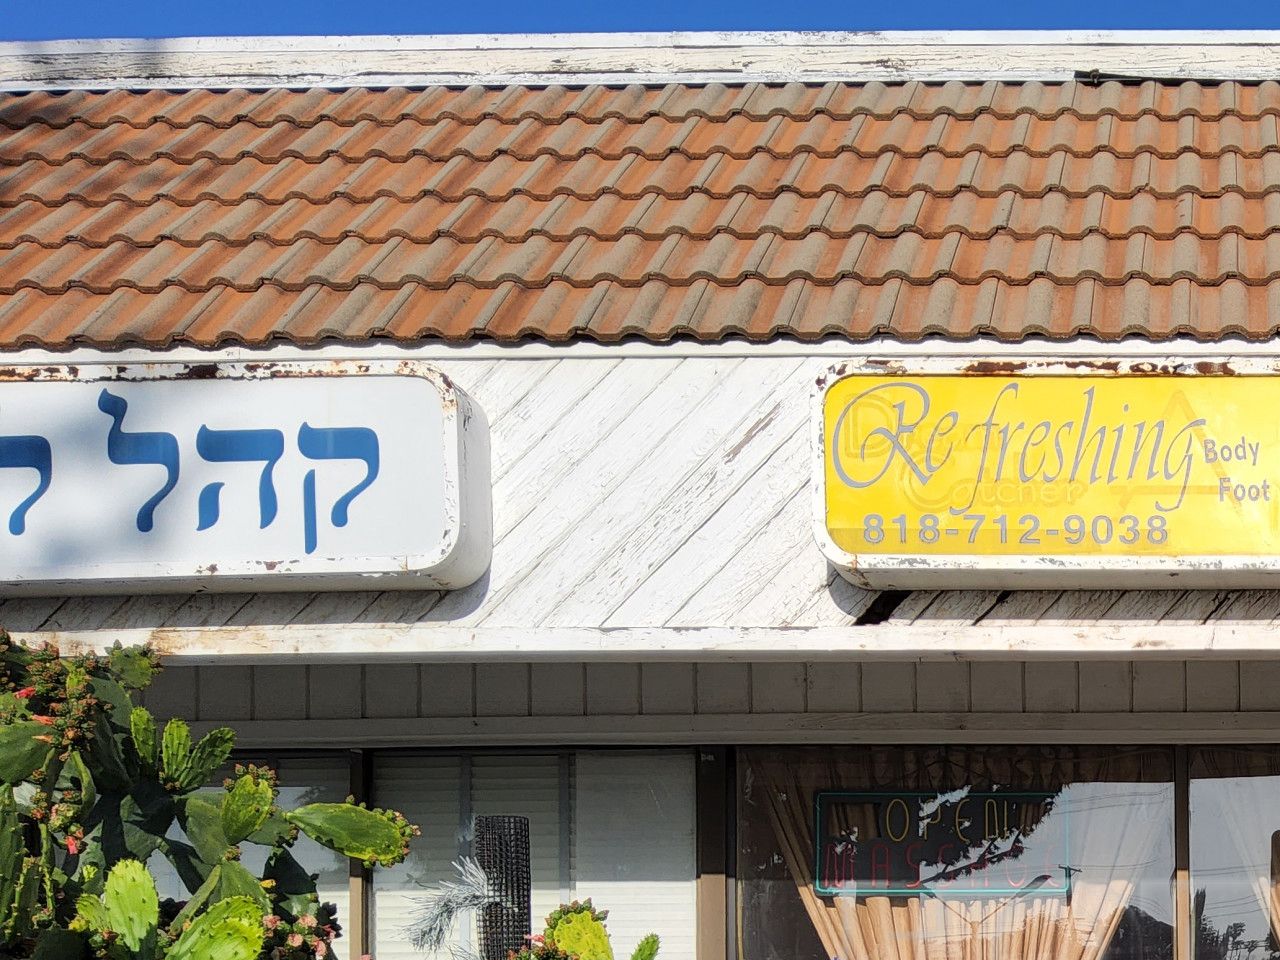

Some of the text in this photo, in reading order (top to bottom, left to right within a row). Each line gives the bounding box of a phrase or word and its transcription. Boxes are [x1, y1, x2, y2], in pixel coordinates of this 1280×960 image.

[1204, 436, 1260, 466] Body
[98, 388, 380, 554] קהל
[1219, 478, 1271, 502] Foot
[863, 514, 1169, 545] 818-712-9038
